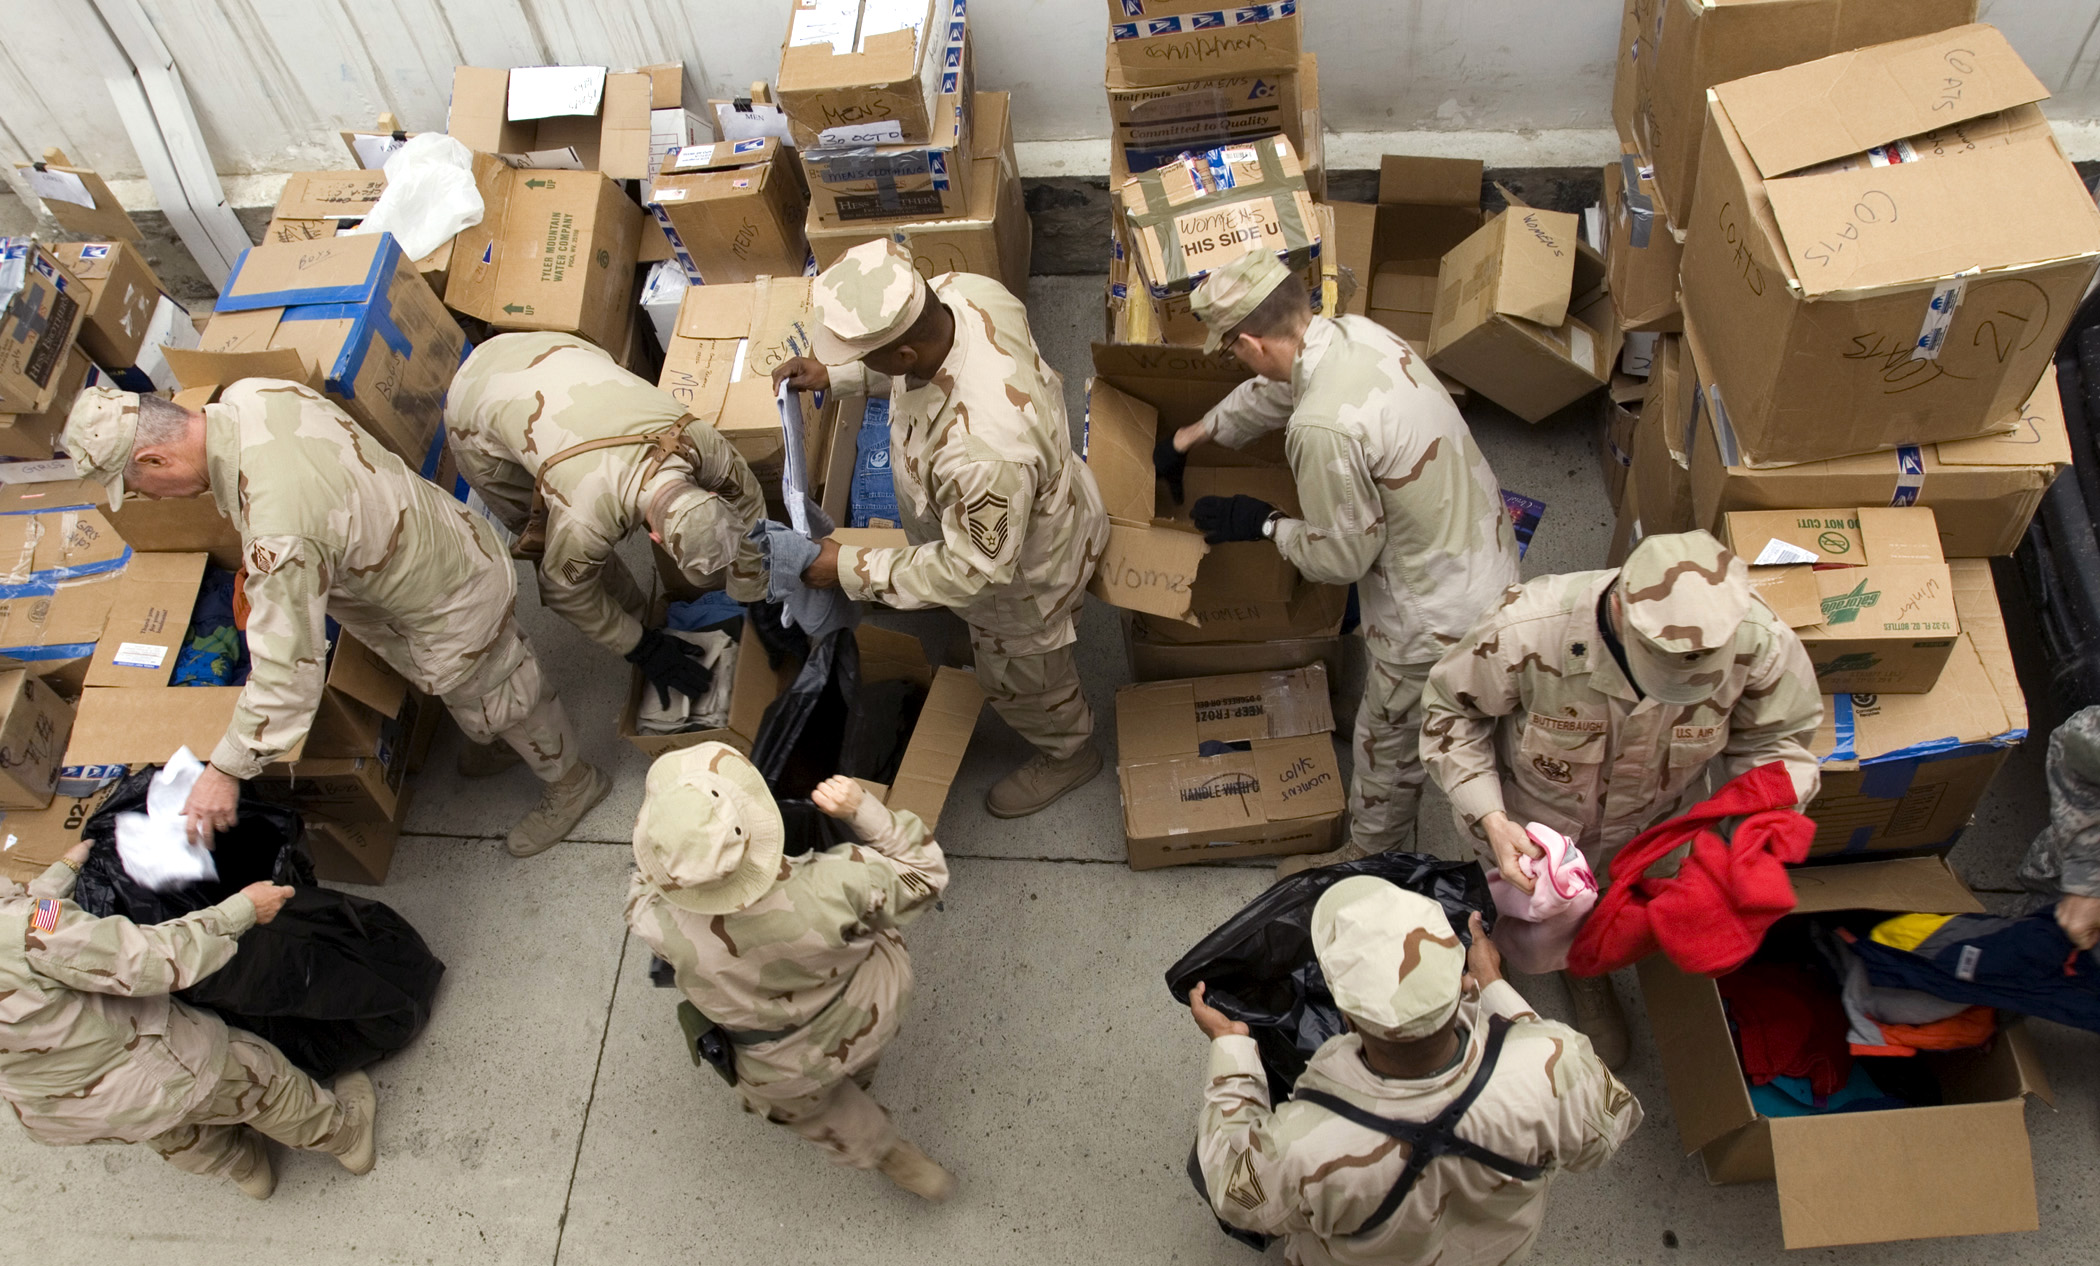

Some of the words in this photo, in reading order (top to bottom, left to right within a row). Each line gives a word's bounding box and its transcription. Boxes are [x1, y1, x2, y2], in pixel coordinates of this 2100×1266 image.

[1932, 49, 1975, 111] COATS
[1113, 93, 1137, 102] Half
[1142, 90, 1171, 100] Pints
[745, 113, 765, 121] MEN
[822, 99, 891, 125] MENS
[1129, 123, 1200, 139] Committed
[1203, 122, 1217, 132] to
[1219, 115, 1269, 131] Quality
[852, 133, 883, 142] OCT
[546, 179, 556, 189] UP
[546, 212, 561, 254] MOUNTAIN
[1805, 189, 1898, 267] COATS
[553, 254, 565, 282] WATER
[559, 214, 573, 252] COMPANY
[1181, 238, 1215, 257] HIS
[1219, 226, 1262, 247] SIDE
[1265, 223, 1283, 237] U
[299, 249, 331, 269] BOYS
[541, 258, 554, 282] TYLER
[525, 305, 535, 315] UP
[215, 336, 238, 352] OYS
[1798, 519, 1821, 528] CUT!
[1825, 519, 1844, 529] NOT
[1821, 591, 1880, 614] Gatorade
[1898, 578, 1939, 620] Winter
[1883, 623, 1909, 631] BOTTLES
[1932, 622, 1950, 630] 12-32
[1195, 709, 1230, 723] FROZE
[1233, 705, 1263, 717] KEEP
[1532, 714, 1604, 731] BUTTERBAUGH
[1676, 728, 1694, 739] U.S.
[1697, 728, 1714, 738] AIR
[1180, 784, 1221, 802] HANDLE
[1222, 781, 1251, 797] WITH
